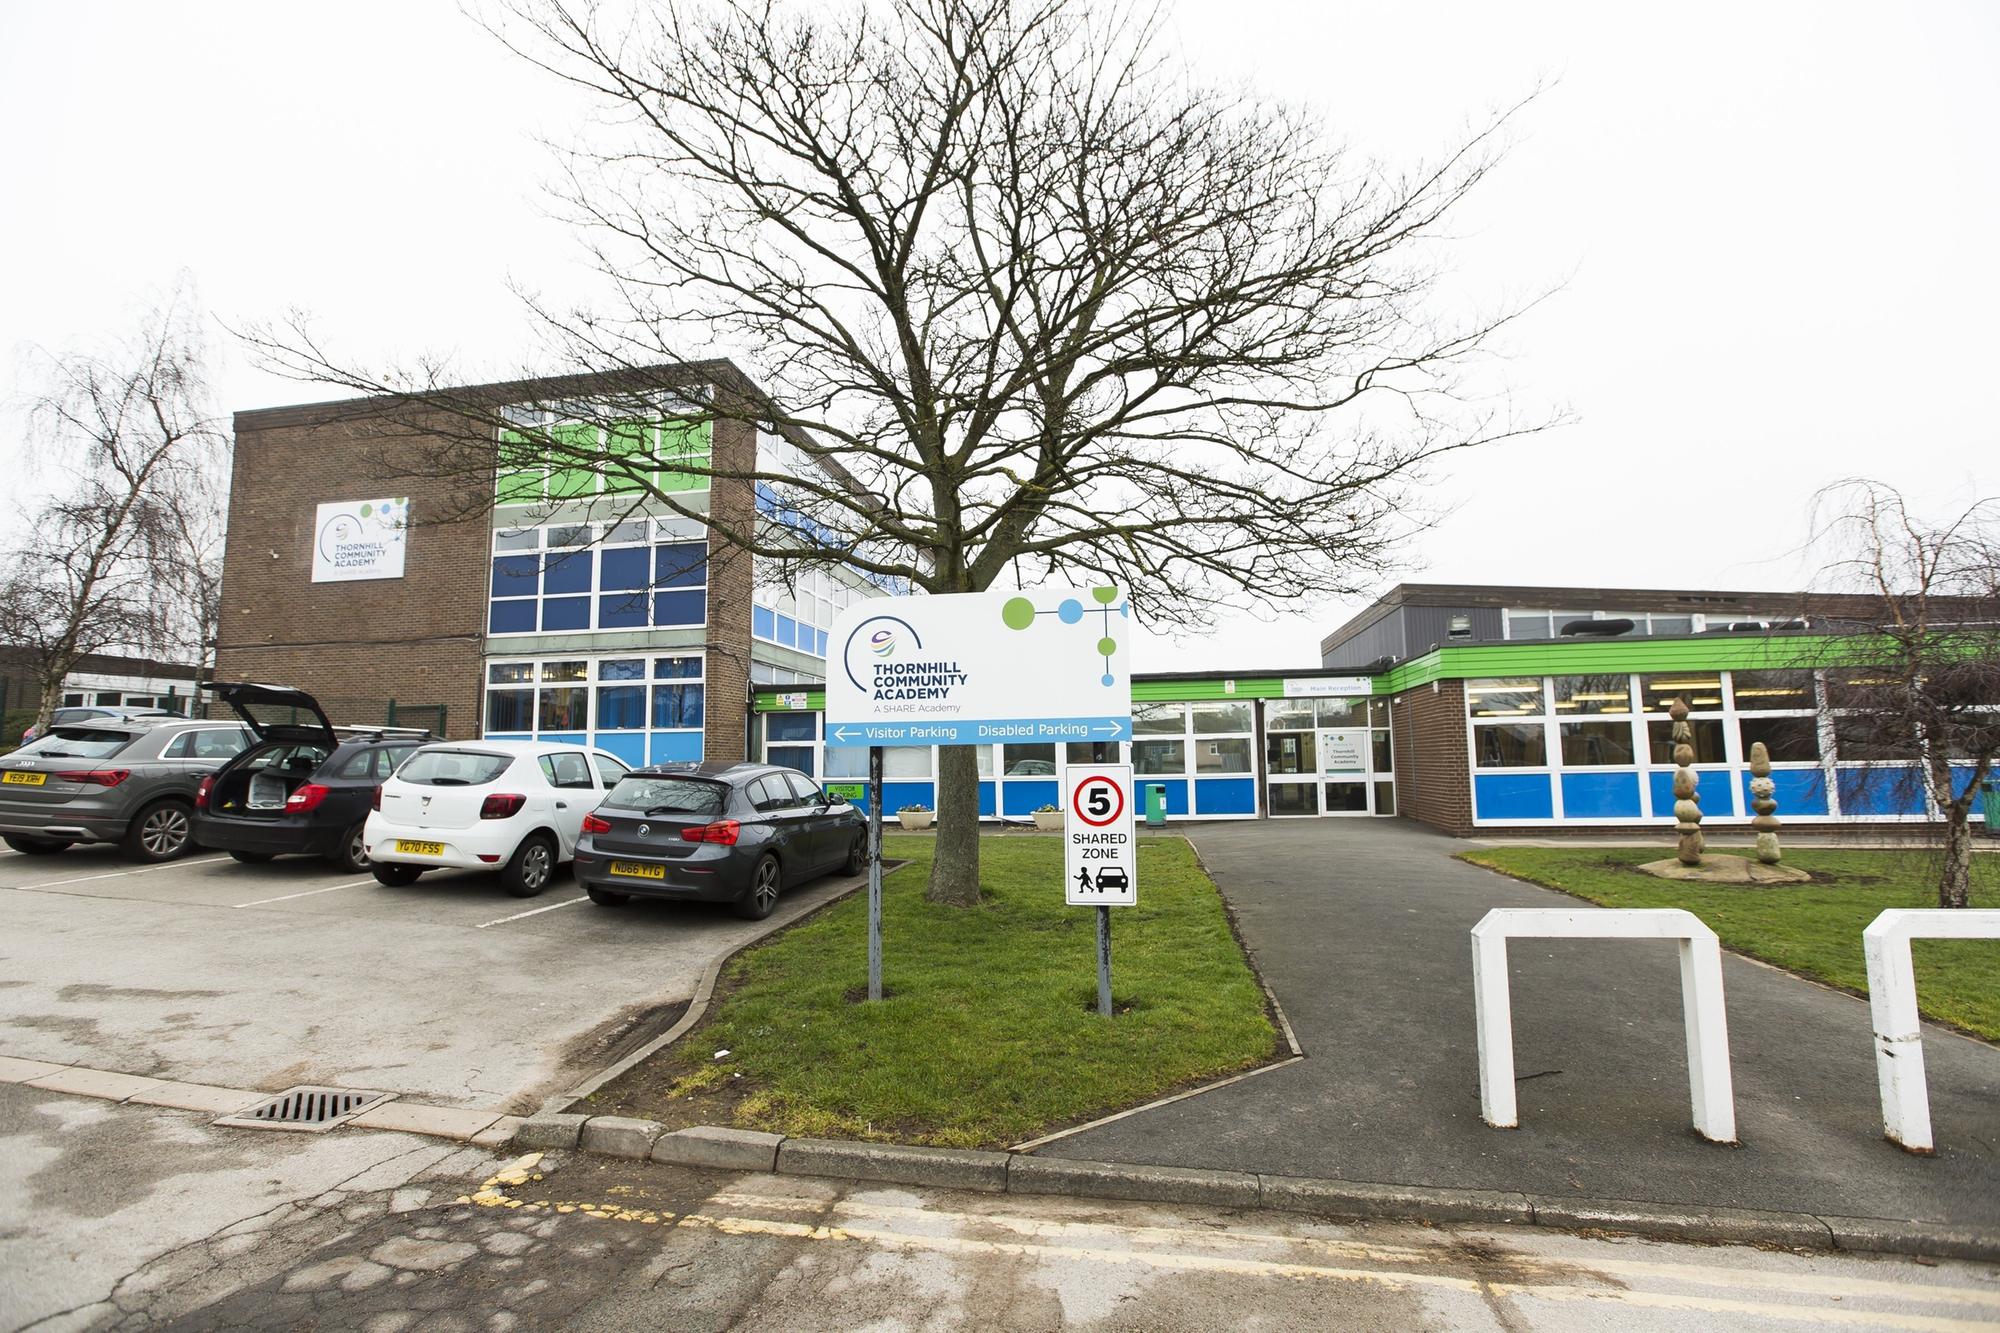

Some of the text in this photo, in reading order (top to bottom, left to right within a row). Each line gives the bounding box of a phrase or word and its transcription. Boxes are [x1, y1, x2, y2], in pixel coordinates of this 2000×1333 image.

[336, 543, 383, 551] THORNHILL
[335, 550, 386, 560] COMMUNITY
[334, 559, 376, 567] ACADEMY
[873, 661, 961, 675] THORNHILL
[873, 674, 968, 688] COMMUNITY
[873, 687, 950, 700] ACADEMY
[874, 703, 961, 713] A SHARE Academy
[865, 726, 957, 740] Visitor Parking
[978, 723, 1088, 738] Disabled Parking
[1087, 787, 1111, 816] 5
[1072, 833, 1127, 844] SHARED
[399, 841, 440, 853] YG70 FSS
[1081, 848, 1119, 859] ZONE
[641, 865, 661, 876] YTG
